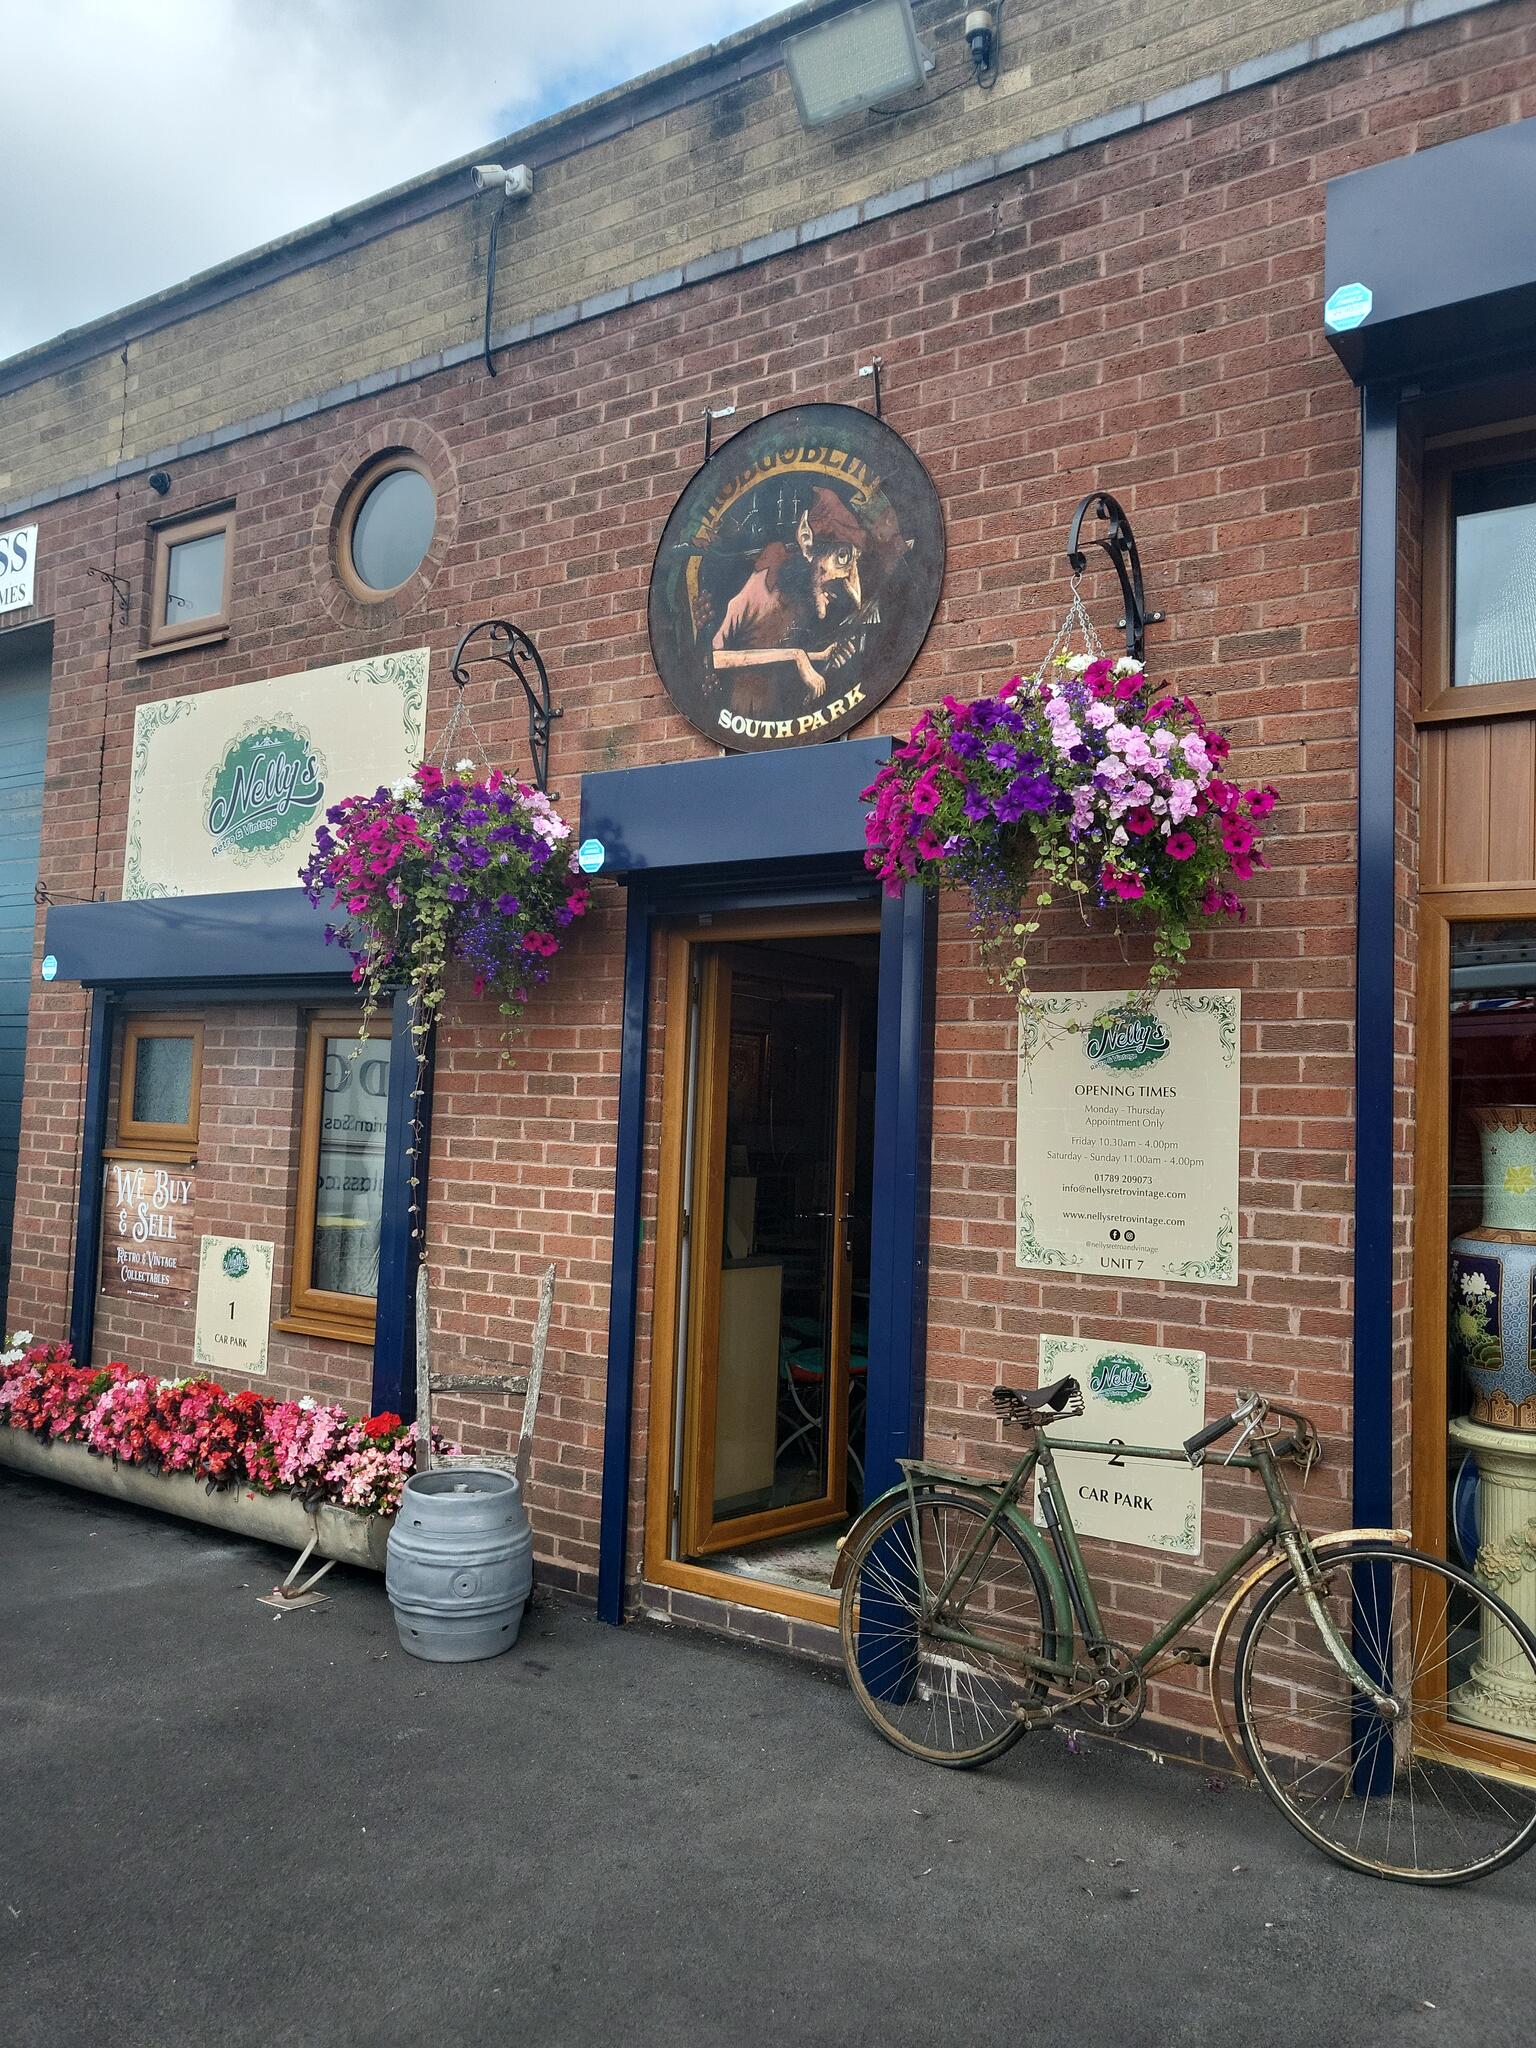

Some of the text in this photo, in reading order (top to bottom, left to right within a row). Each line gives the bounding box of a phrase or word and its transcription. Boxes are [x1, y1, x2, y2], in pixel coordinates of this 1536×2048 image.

[717, 682, 866, 738] SOUTH PARK
[209, 741, 325, 837] Nelly's
[211, 817, 278, 857] Retro & Vintage
[1086, 1016, 1170, 1059] Nelly's
[1074, 1084, 1177, 1098] OPENING TIMES
[1084, 1105, 1118, 1116] Monday
[1126, 1105, 1165, 1116] Thursday
[1085, 1117, 1164, 1129] Appointment Only
[1071, 1137, 1096, 1147] Friday
[1099, 1138, 1136, 1147] 10.30am
[1144, 1140, 1179, 1151] 4.00pm
[1047, 1151, 1082, 1162] Saturday
[1090, 1152, 1121, 1164] Sunday
[1123, 1154, 1161, 1165] 11.00am
[1169, 1156, 1205, 1168] 4.00pm
[1094, 1173, 1153, 1185] 01789 209073
[1062, 1183, 1186, 1200] info@nellysretrovintage.com
[1062, 1211, 1186, 1227] www.nellysretrovintage.com
[1100, 1257, 1144, 1271] UNIT 7
[229, 1301, 235, 1320] 1
[214, 1333, 247, 1348] CAR PARK
[1089, 1364, 1152, 1393] Nelly's
[1108, 1438, 1125, 1467] 2
[1078, 1486, 1153, 1511] CAR PARK
